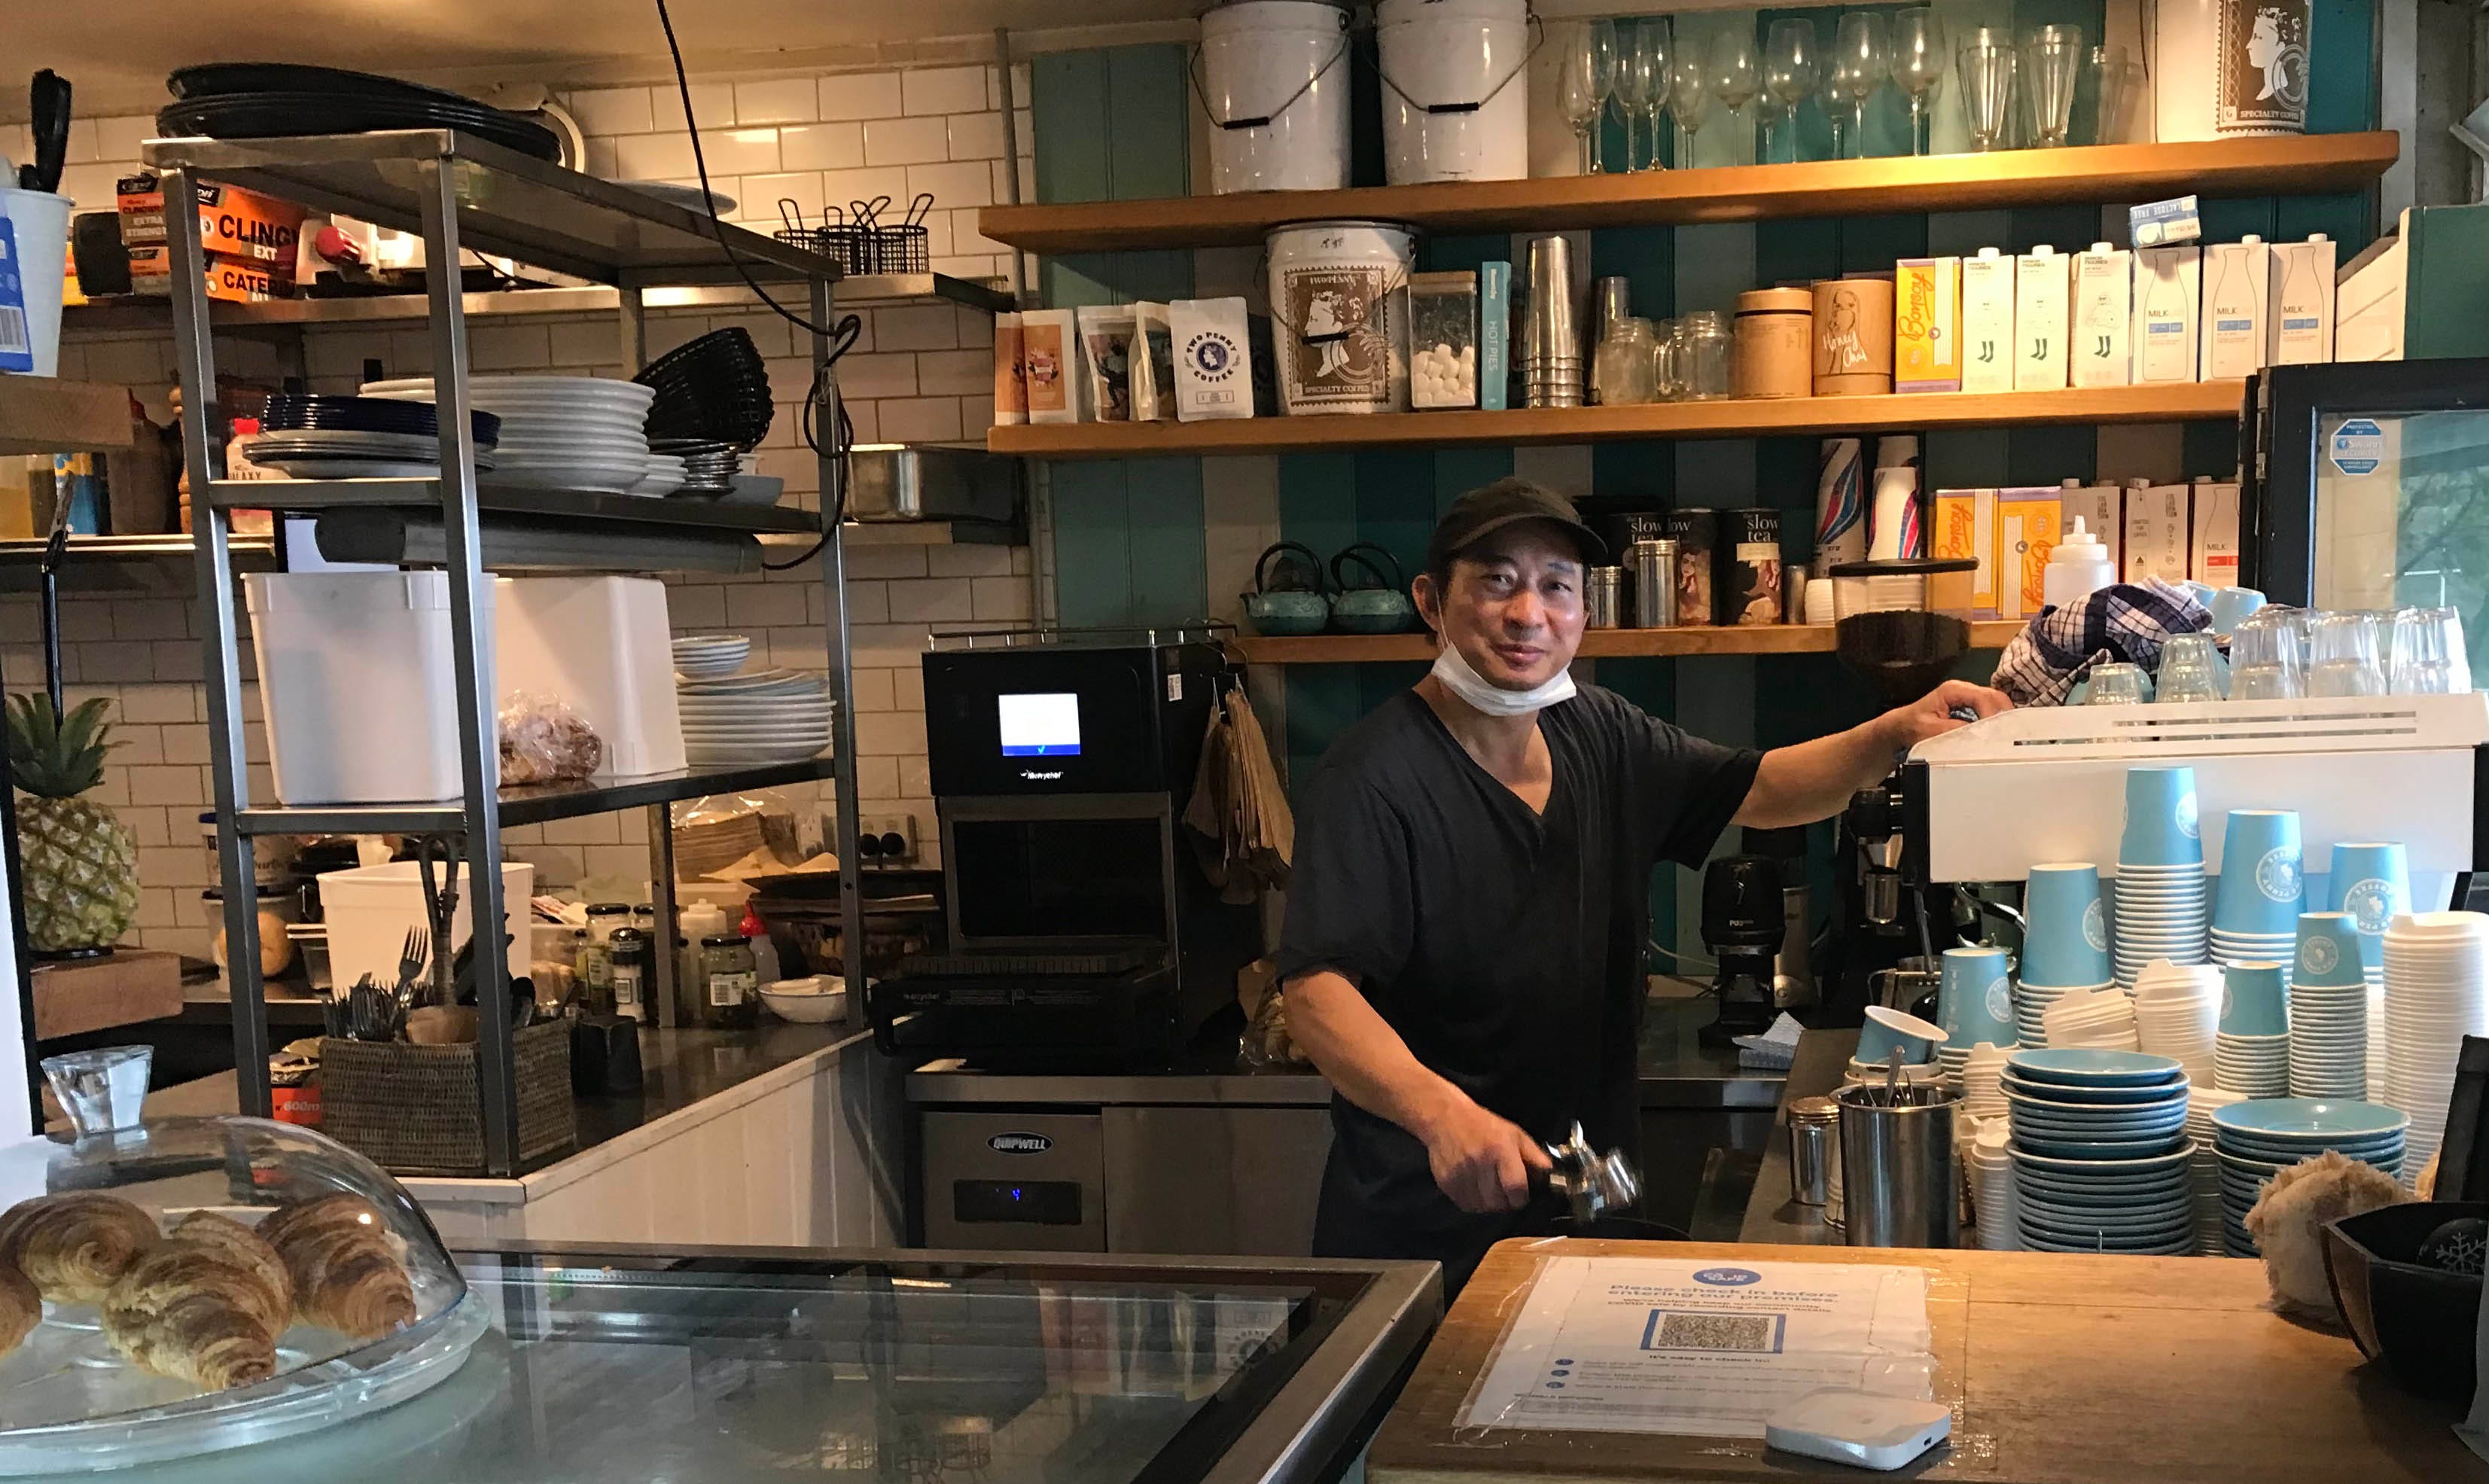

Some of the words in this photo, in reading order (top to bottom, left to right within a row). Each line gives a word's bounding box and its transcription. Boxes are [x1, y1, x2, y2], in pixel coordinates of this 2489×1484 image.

[2240, 110, 2280, 118] SPECIALTY
[1898, 271, 1935, 340] Bonsoy
[1488, 320, 1498, 345] HOT
[1186, 334, 1203, 353] TWO
[1206, 332, 1237, 352] PENNY
[1823, 331, 1858, 353] Honey
[1488, 347, 1498, 373] PIES
[1194, 368, 1234, 382] COFFEE
[1305, 385, 1342, 394] SPECIALTY
[1631, 517, 1662, 533] slow
[1747, 513, 1779, 530] slow
[1748, 530, 1771, 543] tea
